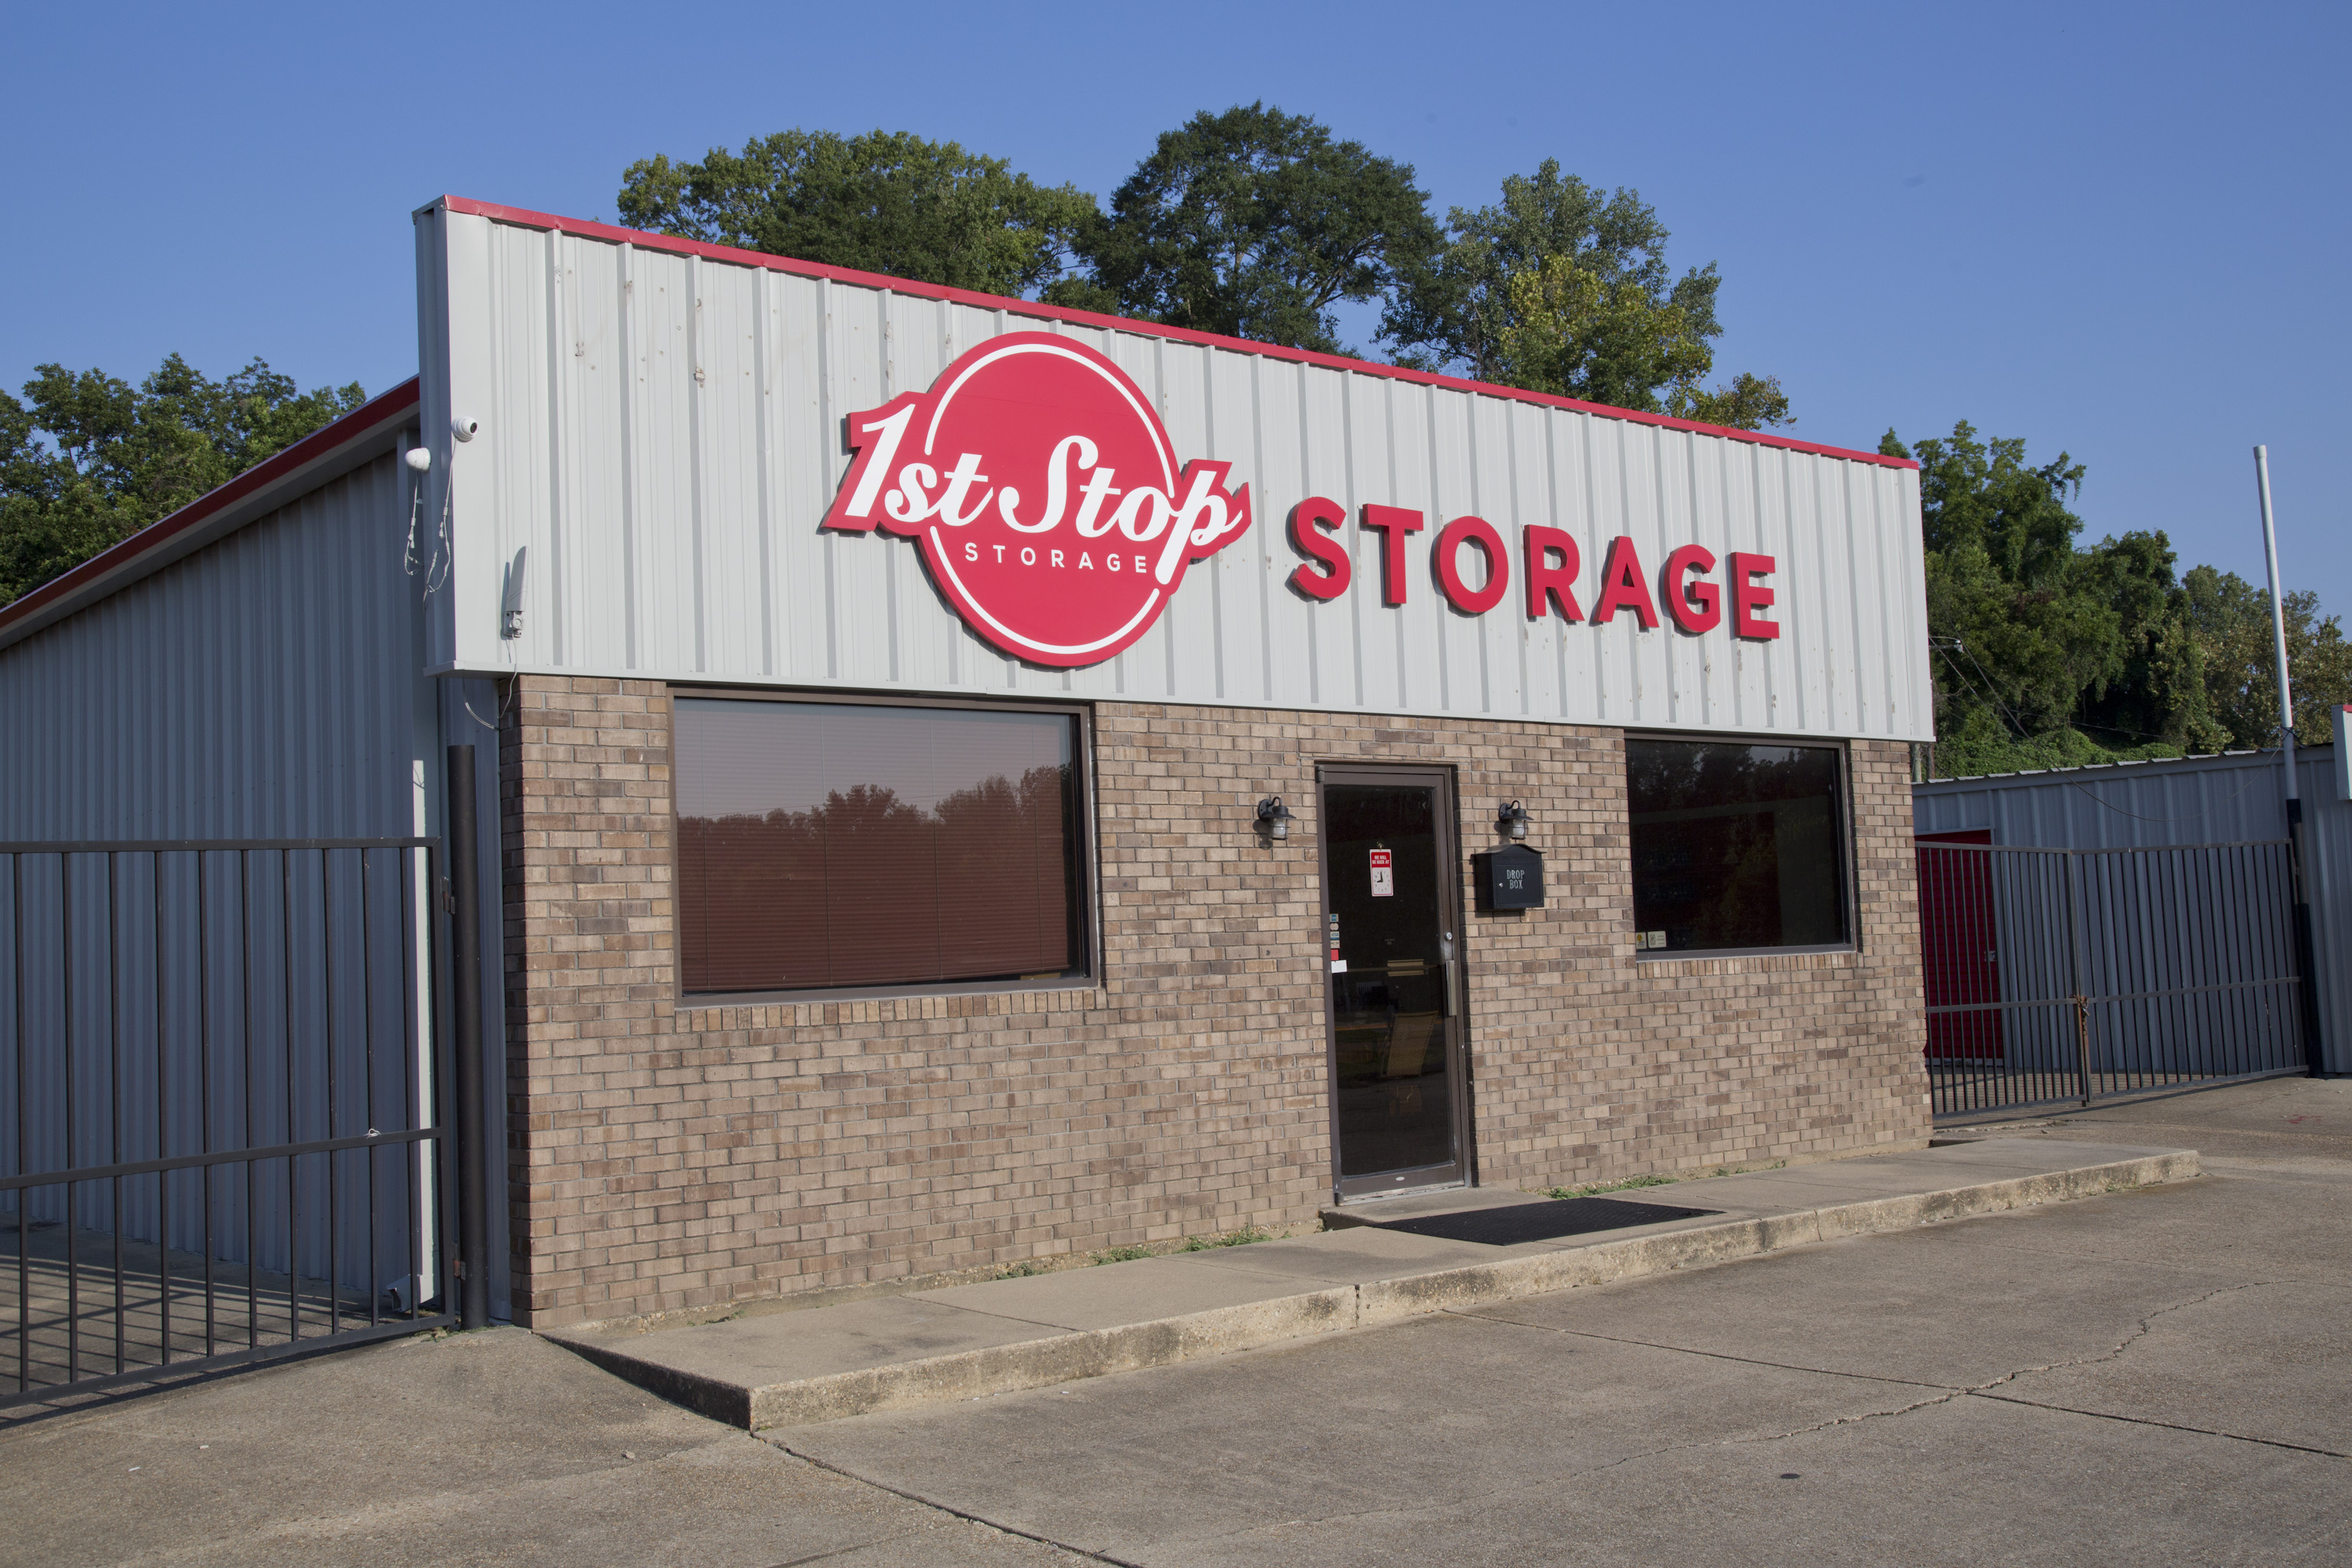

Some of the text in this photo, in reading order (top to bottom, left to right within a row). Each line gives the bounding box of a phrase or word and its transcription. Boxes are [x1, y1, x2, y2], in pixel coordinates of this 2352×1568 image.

[844, 403, 1243, 585] 1st Stop
[965, 542, 1147, 573] STORAGE
[1290, 496, 1780, 640] STORAGE
[1506, 869, 1525, 879] DROP
[1509, 879, 1523, 889] BOX
